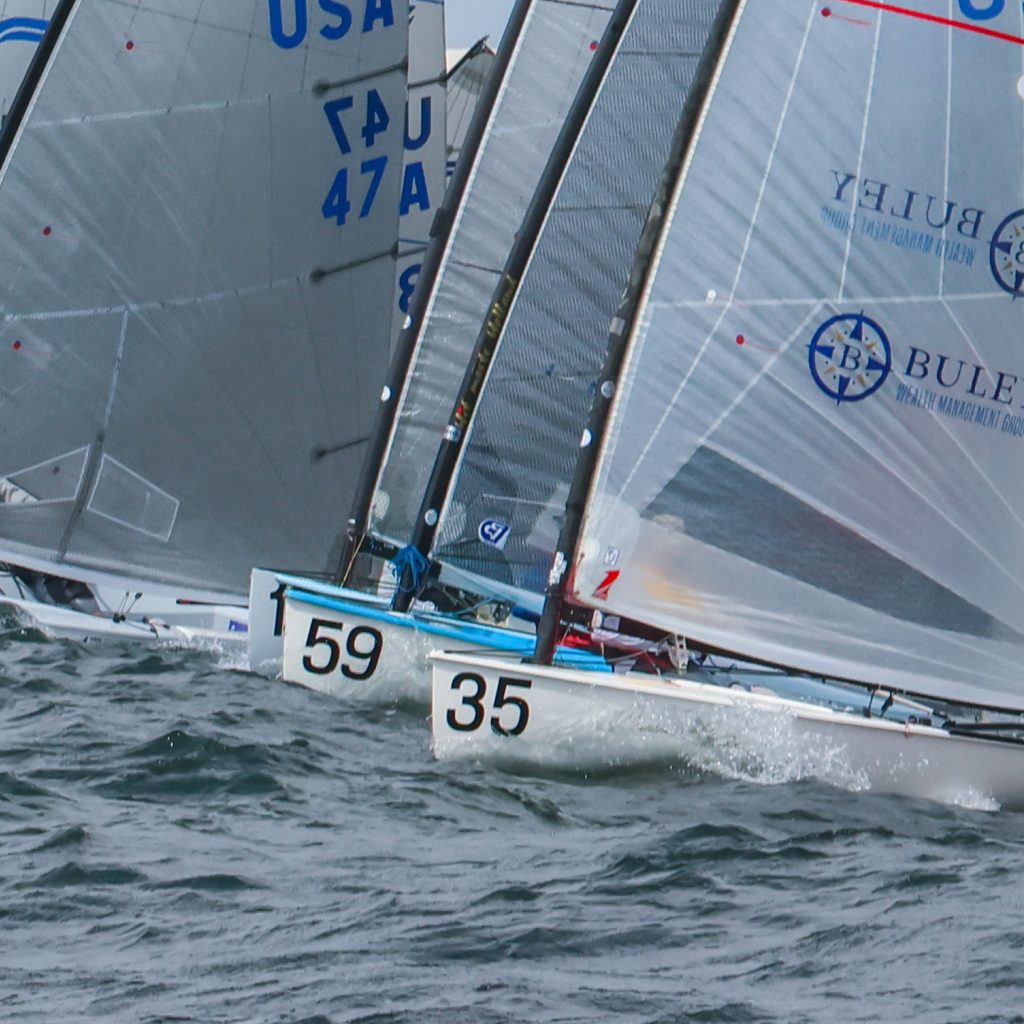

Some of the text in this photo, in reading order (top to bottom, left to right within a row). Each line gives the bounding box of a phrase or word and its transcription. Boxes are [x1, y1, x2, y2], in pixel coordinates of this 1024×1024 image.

[321, 155, 388, 226] 47
[839, 343, 862, 371] B
[905, 346, 1024, 408] BULE
[937, 394, 1001, 429] MANAGEMENT
[302, 618, 384, 680] 59
[446, 672, 533, 738] 35
